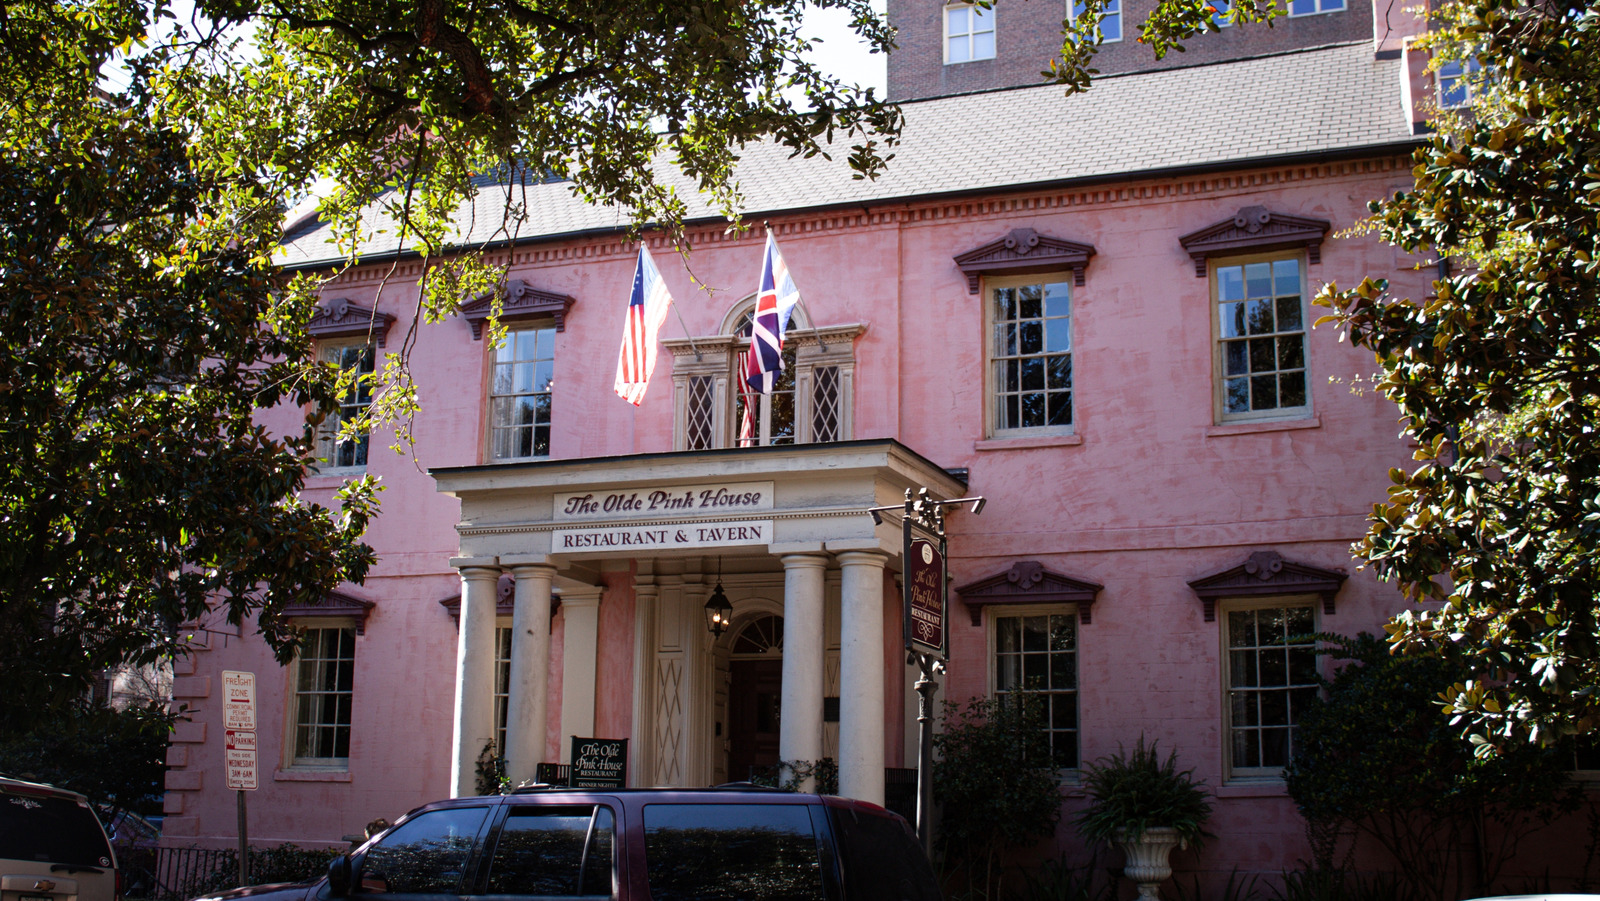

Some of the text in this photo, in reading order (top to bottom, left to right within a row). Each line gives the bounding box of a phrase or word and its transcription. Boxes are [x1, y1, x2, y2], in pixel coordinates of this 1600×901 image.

[564, 487, 762, 515] The Olde Pink House
[563, 526, 762, 548] RESTAURANT & TAVERN
[911, 585, 941, 610] Pink House
[912, 608, 940, 625] RESTAURANT
[225, 677, 252, 687] FREIGHT
[230, 688, 248, 697] ZONE
[226, 734, 255, 746] NO PARKING
[581, 743, 620, 757] The Olde
[228, 760, 254, 768] WEDNESDAY
[574, 754, 623, 771] Pink House
